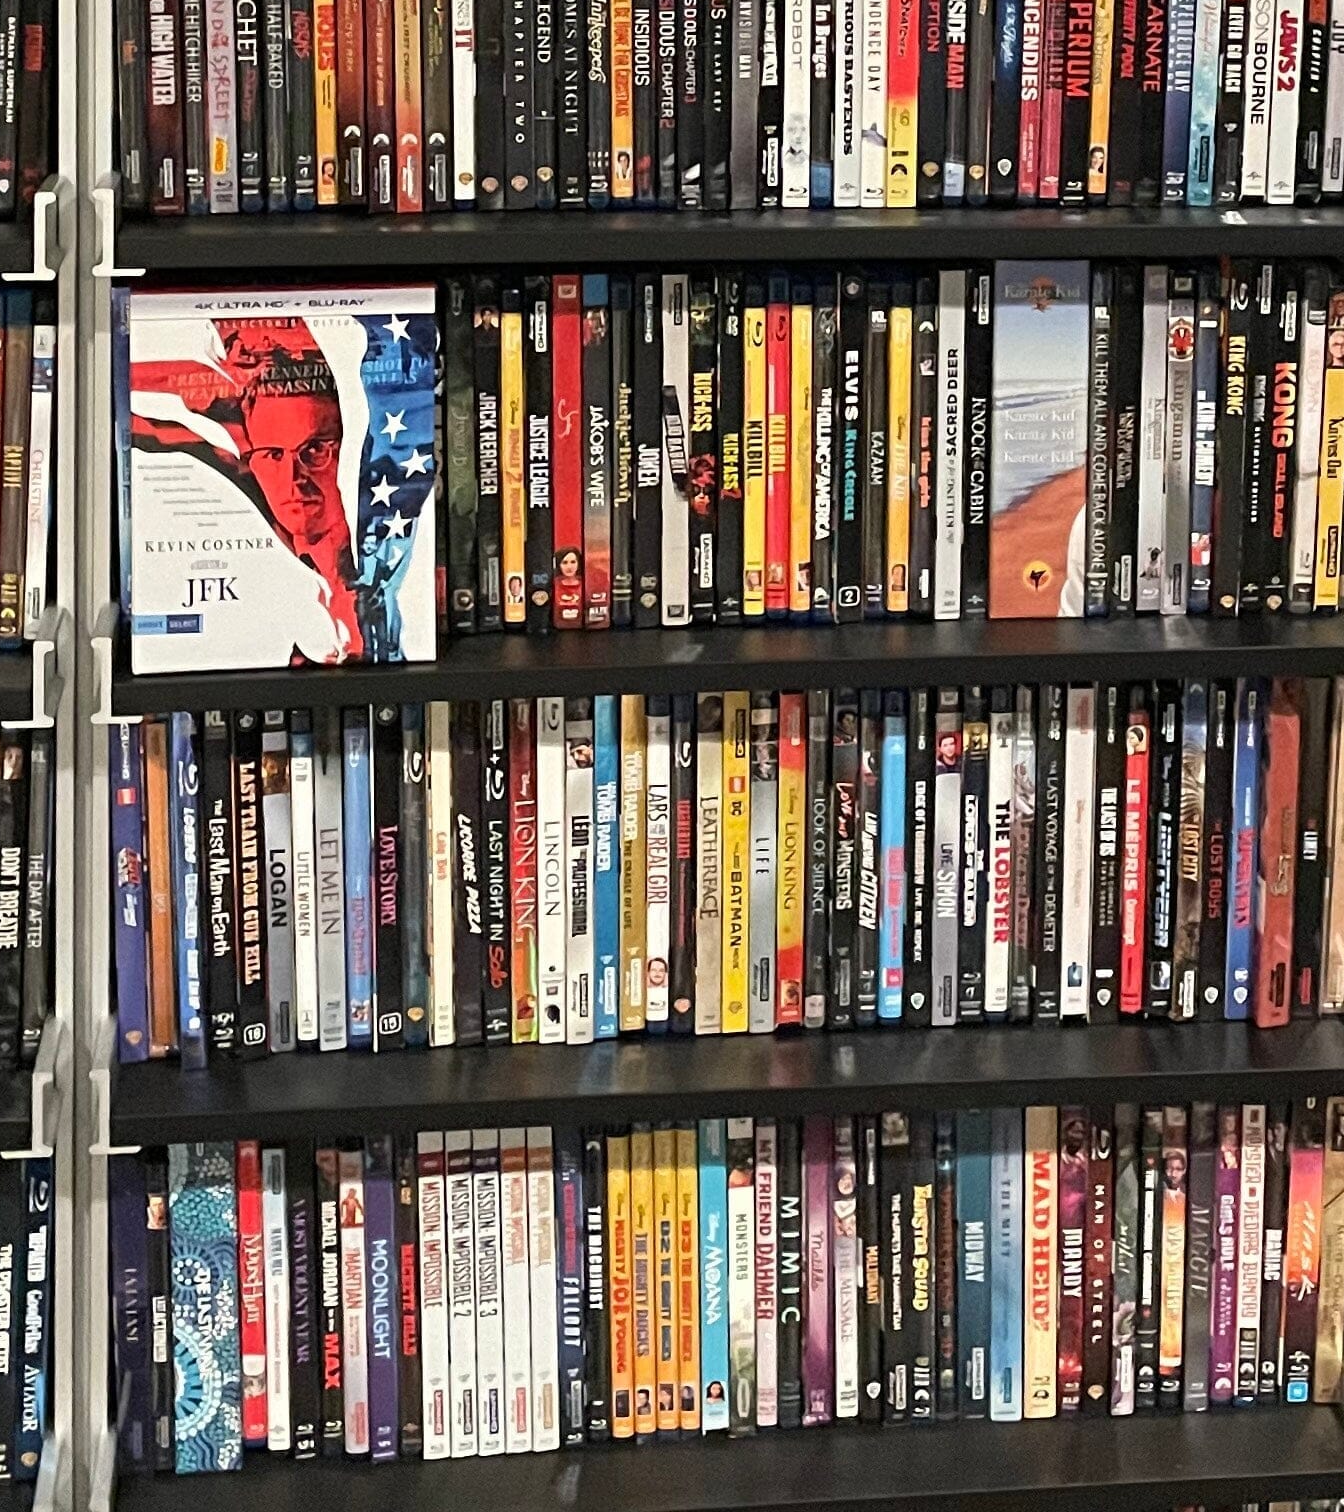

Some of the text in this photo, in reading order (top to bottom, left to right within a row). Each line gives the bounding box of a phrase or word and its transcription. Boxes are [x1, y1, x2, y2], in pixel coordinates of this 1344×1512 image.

[633, 8, 650, 85] INSIDIOUS
[1277, 9, 1298, 92] JAWS 2
[195, 302, 213, 310] 4K
[218, 301, 261, 309] ULTRA
[308, 298, 365, 308] BLU-RAY
[1272, 362, 1297, 447] KONG
[870, 430, 885, 485] KAZAAM
[146, 538, 273, 552] KEVIN COSTNER
[183, 576, 240, 607] JFK
[270, 849, 288, 928] LOGAN
[543, 820, 561, 915] LINCOLN
[700, 795, 721, 919] LEATHERFACE
[992, 800, 1011, 944] THE LOBSTER
[757, 1138, 774, 1320] MY FRIEND DAHMER
[781, 1196, 800, 1324] MIMIC
[964, 1222, 985, 1282] MIDWAY
[372, 1239, 390, 1357] MOONLIGHT
